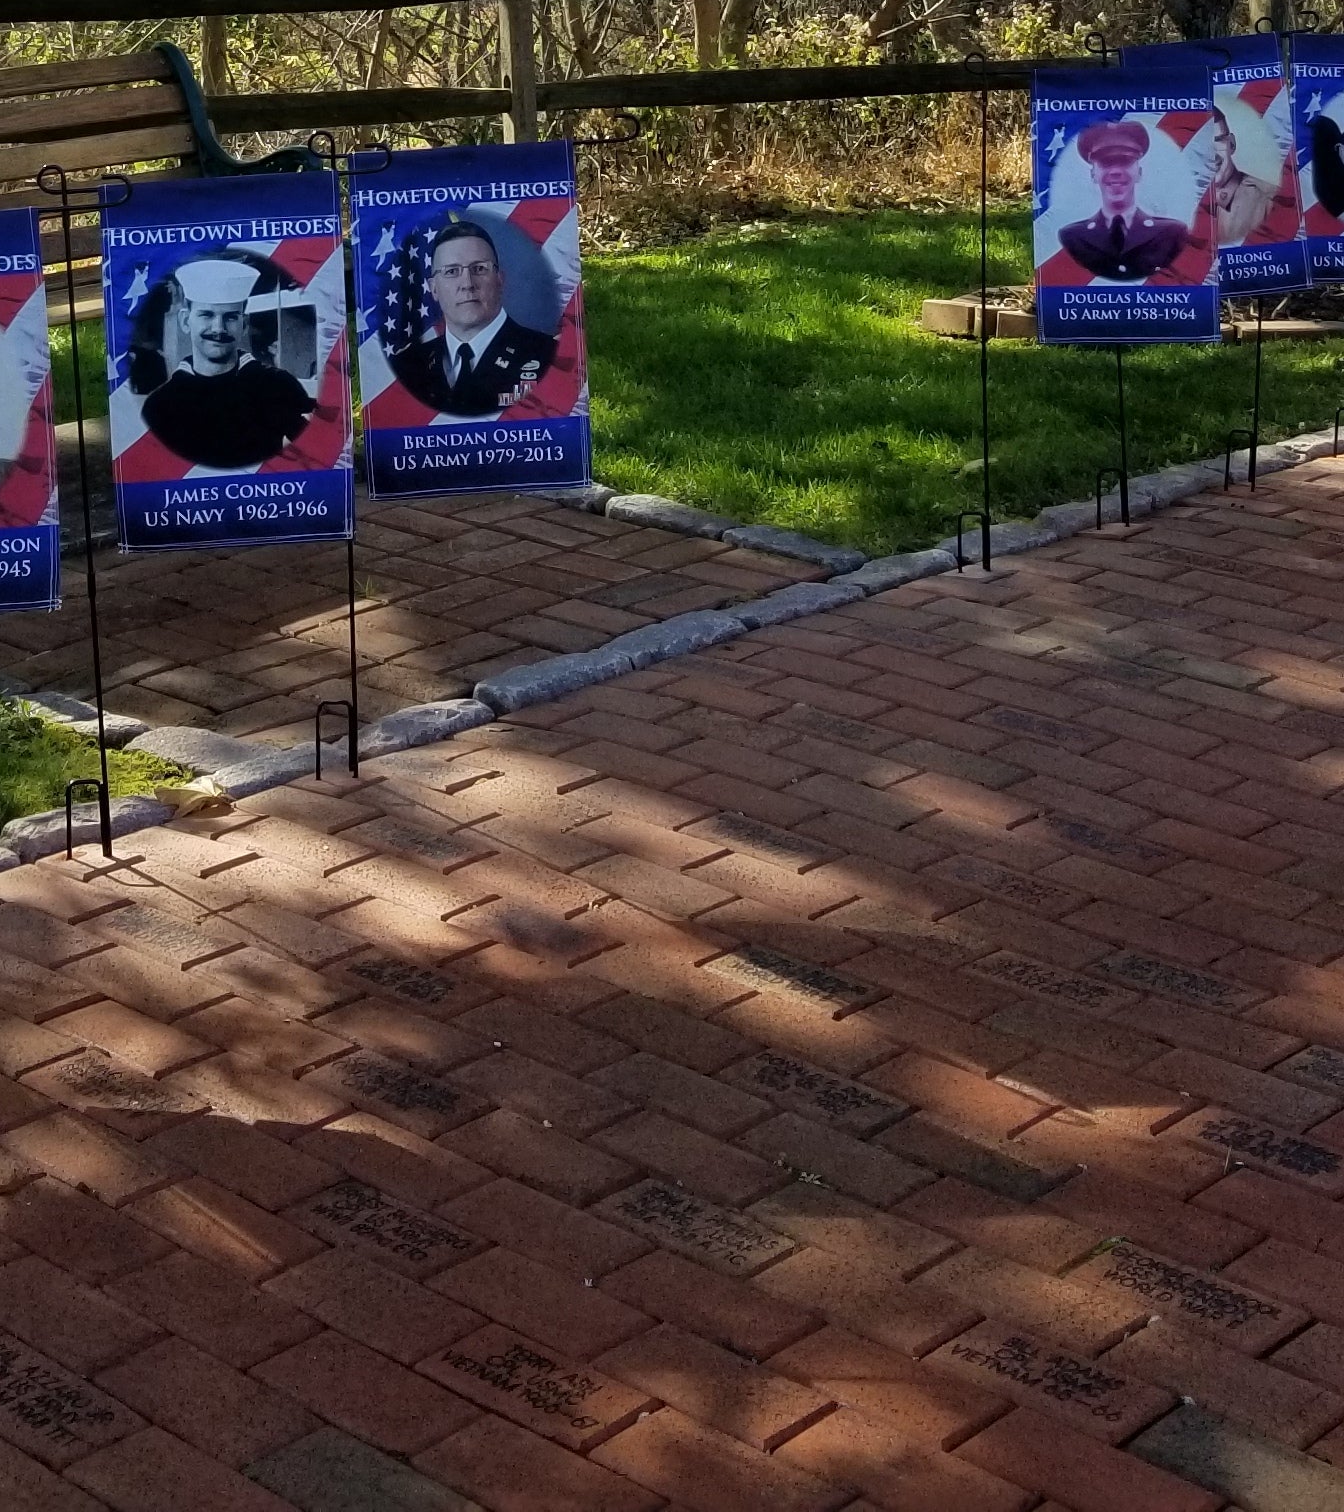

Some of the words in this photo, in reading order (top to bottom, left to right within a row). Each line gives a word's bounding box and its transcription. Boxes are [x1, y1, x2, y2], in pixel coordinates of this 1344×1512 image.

[1223, 65, 1280, 82] HEROES
[1036, 98, 1137, 112] HOMETOWN
[1142, 97, 1207, 110] HEROES
[357, 186, 482, 208] HOMETOWN
[490, 180, 569, 199] HEROES
[110, 223, 242, 247] HOMETOWN
[251, 217, 335, 238] HEROES
[1227, 250, 1273, 265] BRONG
[1313, 256, 1331, 267] US
[1229, 264, 1290, 280] 1959-1961
[1063, 292, 1131, 304] DOUGLAS
[1136, 292, 1191, 304] KANSKY
[1058, 308, 1079, 320] US
[1081, 308, 1122, 320] ARMY
[1126, 308, 1196, 320] 1958-1964
[403, 431, 487, 450] BRENDAN
[493, 428, 553, 444] OSHEA
[393, 455, 417, 471] US
[421, 453, 471, 469] ARMY
[477, 446, 564, 465] 1979-2013
[164, 487, 219, 508] JAMES
[225, 481, 307, 500] CONROY
[144, 511, 169, 527] US
[176, 508, 226, 525] NAVY
[237, 500, 328, 521] 1962-1966
